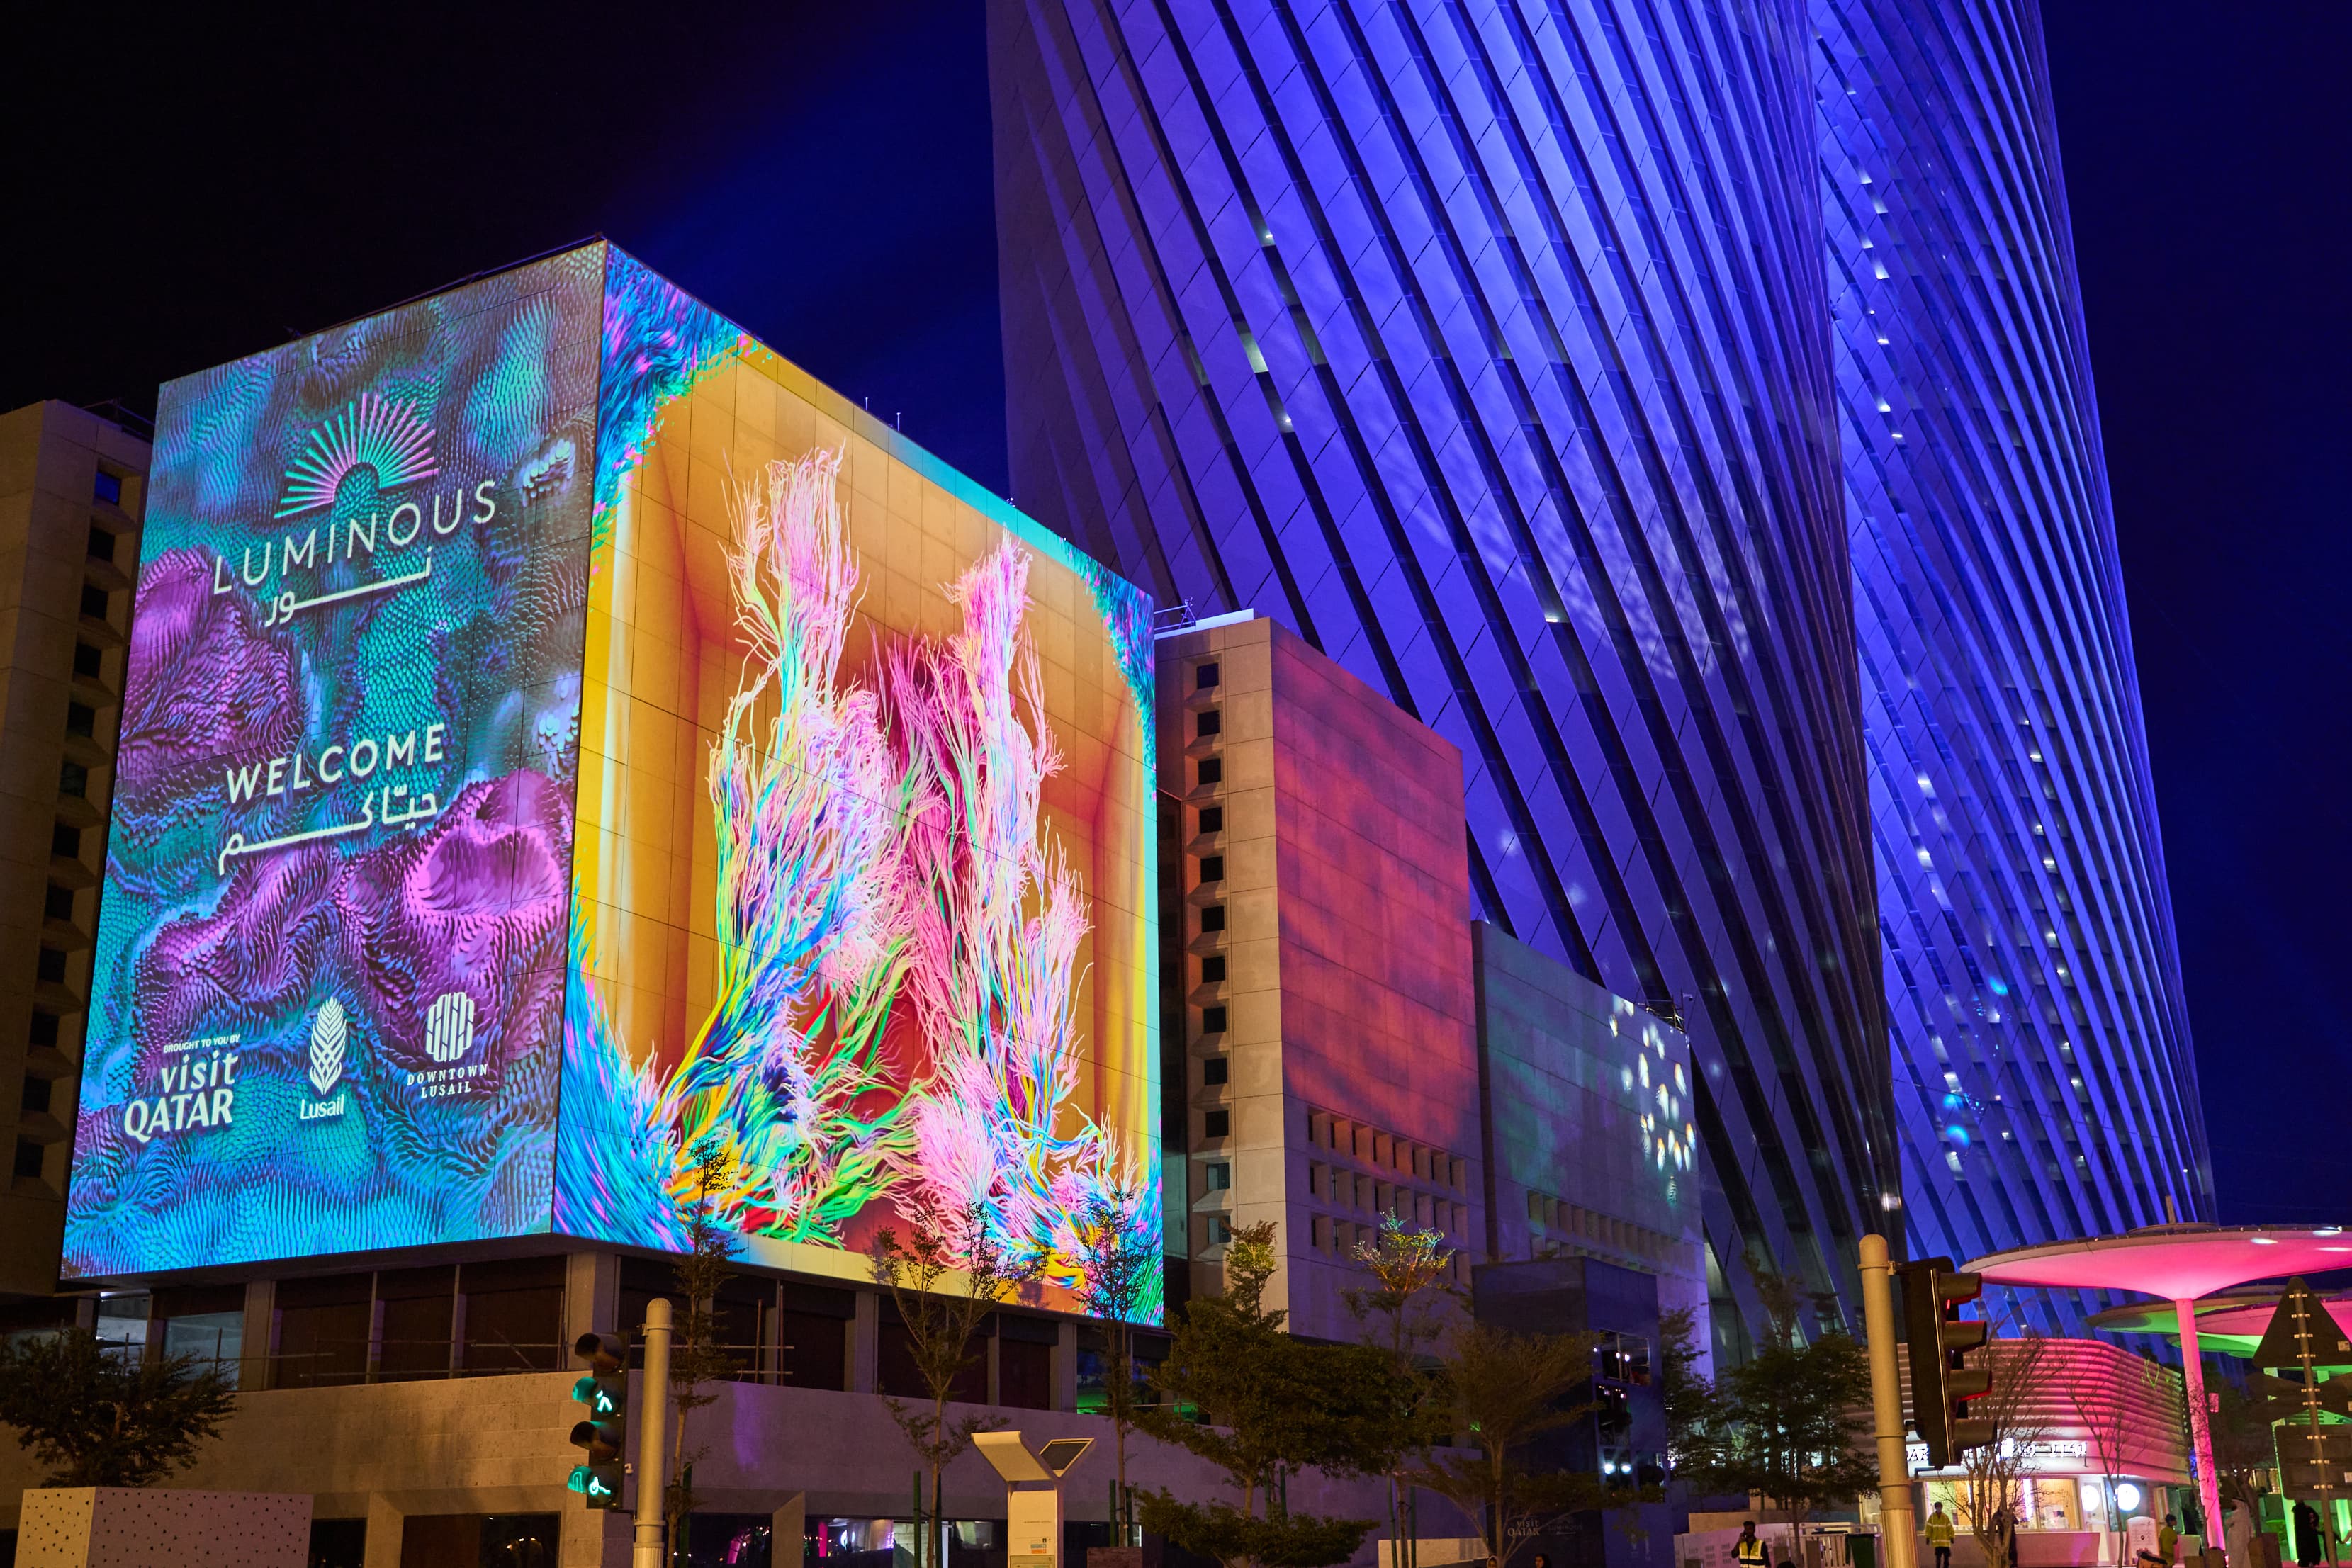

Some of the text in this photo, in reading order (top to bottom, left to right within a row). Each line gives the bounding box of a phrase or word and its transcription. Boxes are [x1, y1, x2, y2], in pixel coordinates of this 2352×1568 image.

[213, 480, 496, 594] LUMINOUS
[227, 723, 444, 803] WELCOME
[163, 1034, 240, 1054] BROUGHT TO YOU BY
[161, 1049, 238, 1093] visit
[407, 1064, 488, 1085] DOWNTOWN
[421, 1081, 472, 1098] LUSAIL
[124, 1088, 234, 1143] QATAR
[300, 1093, 345, 1119] Lusail
[1508, 1528, 1539, 1537] QATAR
